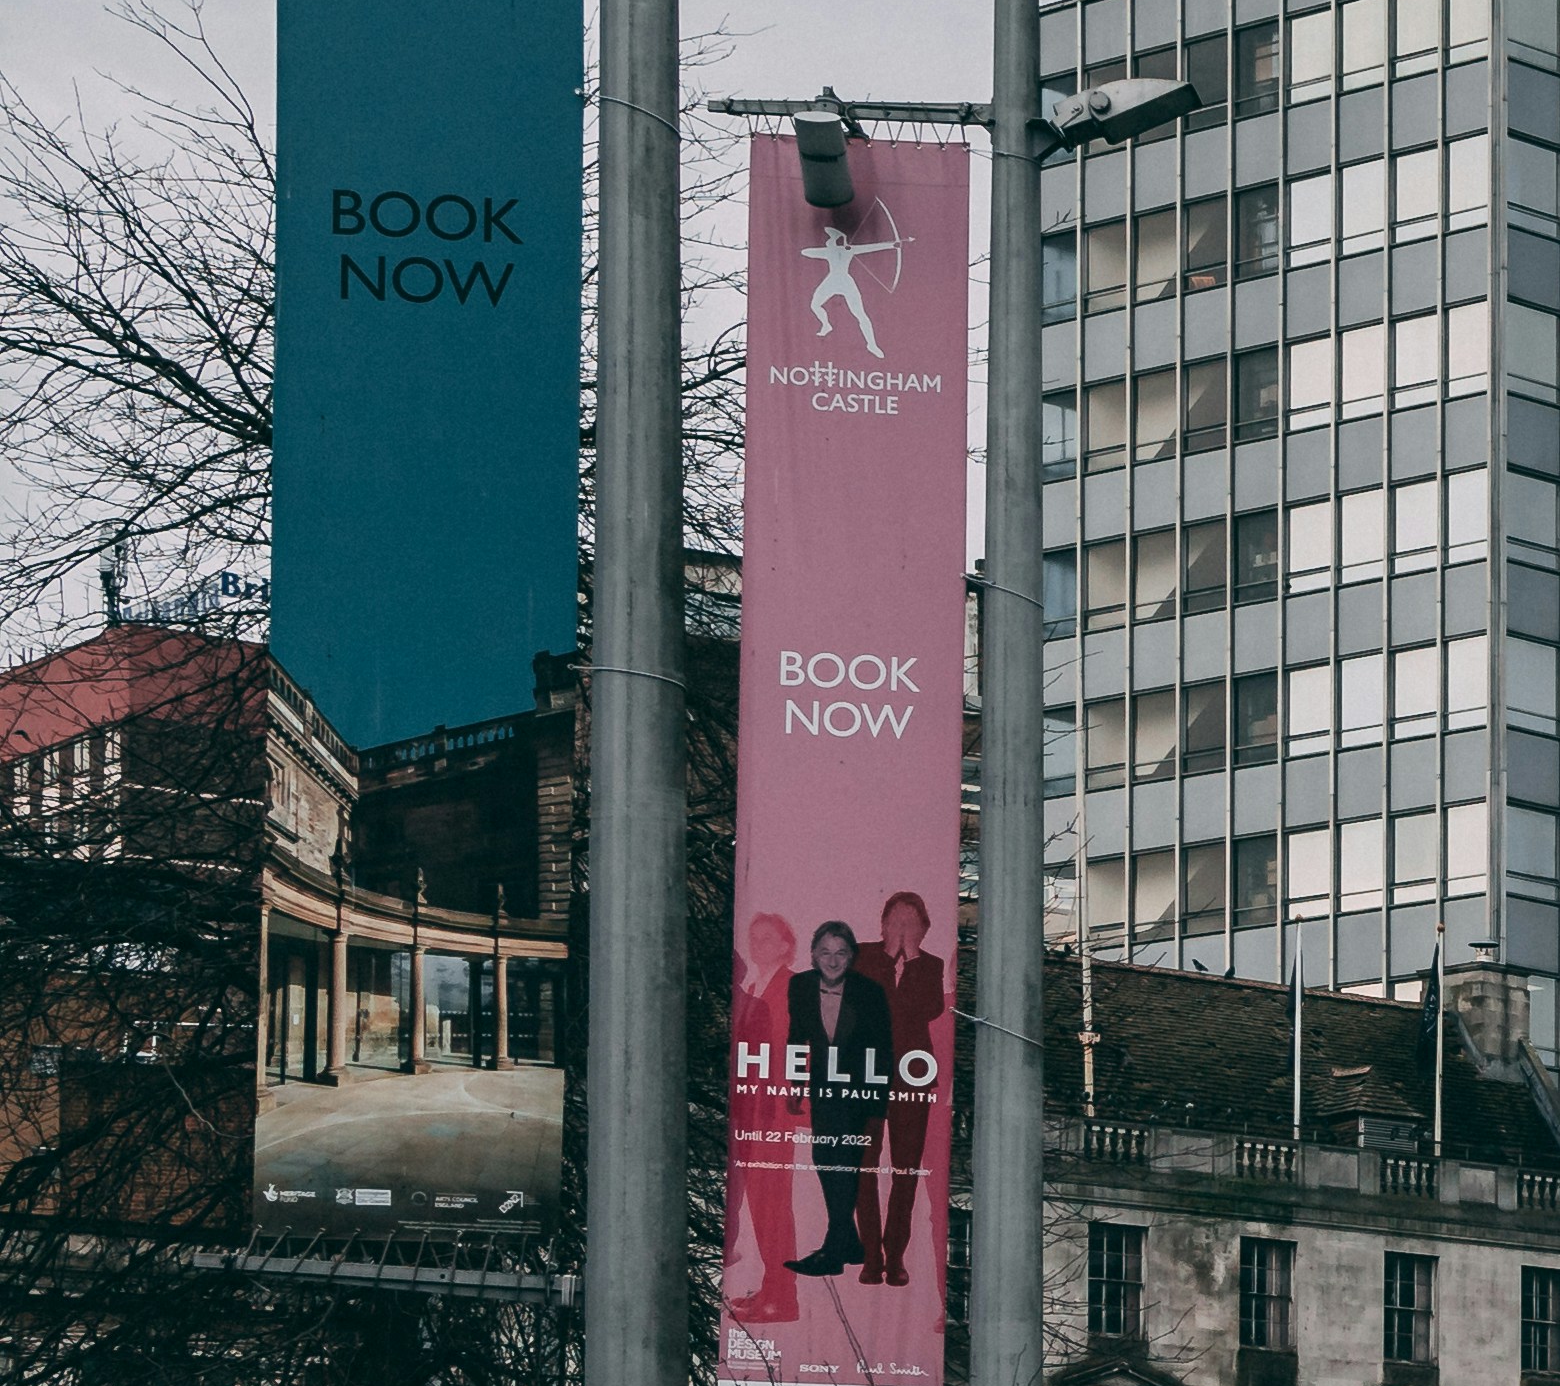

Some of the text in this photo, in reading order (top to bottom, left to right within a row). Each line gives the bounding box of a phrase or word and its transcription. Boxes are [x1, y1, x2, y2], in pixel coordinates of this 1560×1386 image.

[332, 188, 525, 245] BOOK
[340, 253, 515, 309] NOW
[769, 360, 942, 393] NOTTINGHAM
[811, 392, 899, 415] CASTLE
[779, 650, 921, 693] BOOK
[785, 699, 914, 740] NOW
[737, 1041, 938, 1087] HELLO
[736, 1084, 938, 1103] MY NAME IS PAUL SMITH
[734, 1129, 872, 1148] Until 22 February 2022
[728, 1328, 747, 1338] the
[728, 1338, 775, 1350] DESIGN
[727, 1348, 782, 1361] MUSEUM
[799, 1364, 840, 1373] SONY
